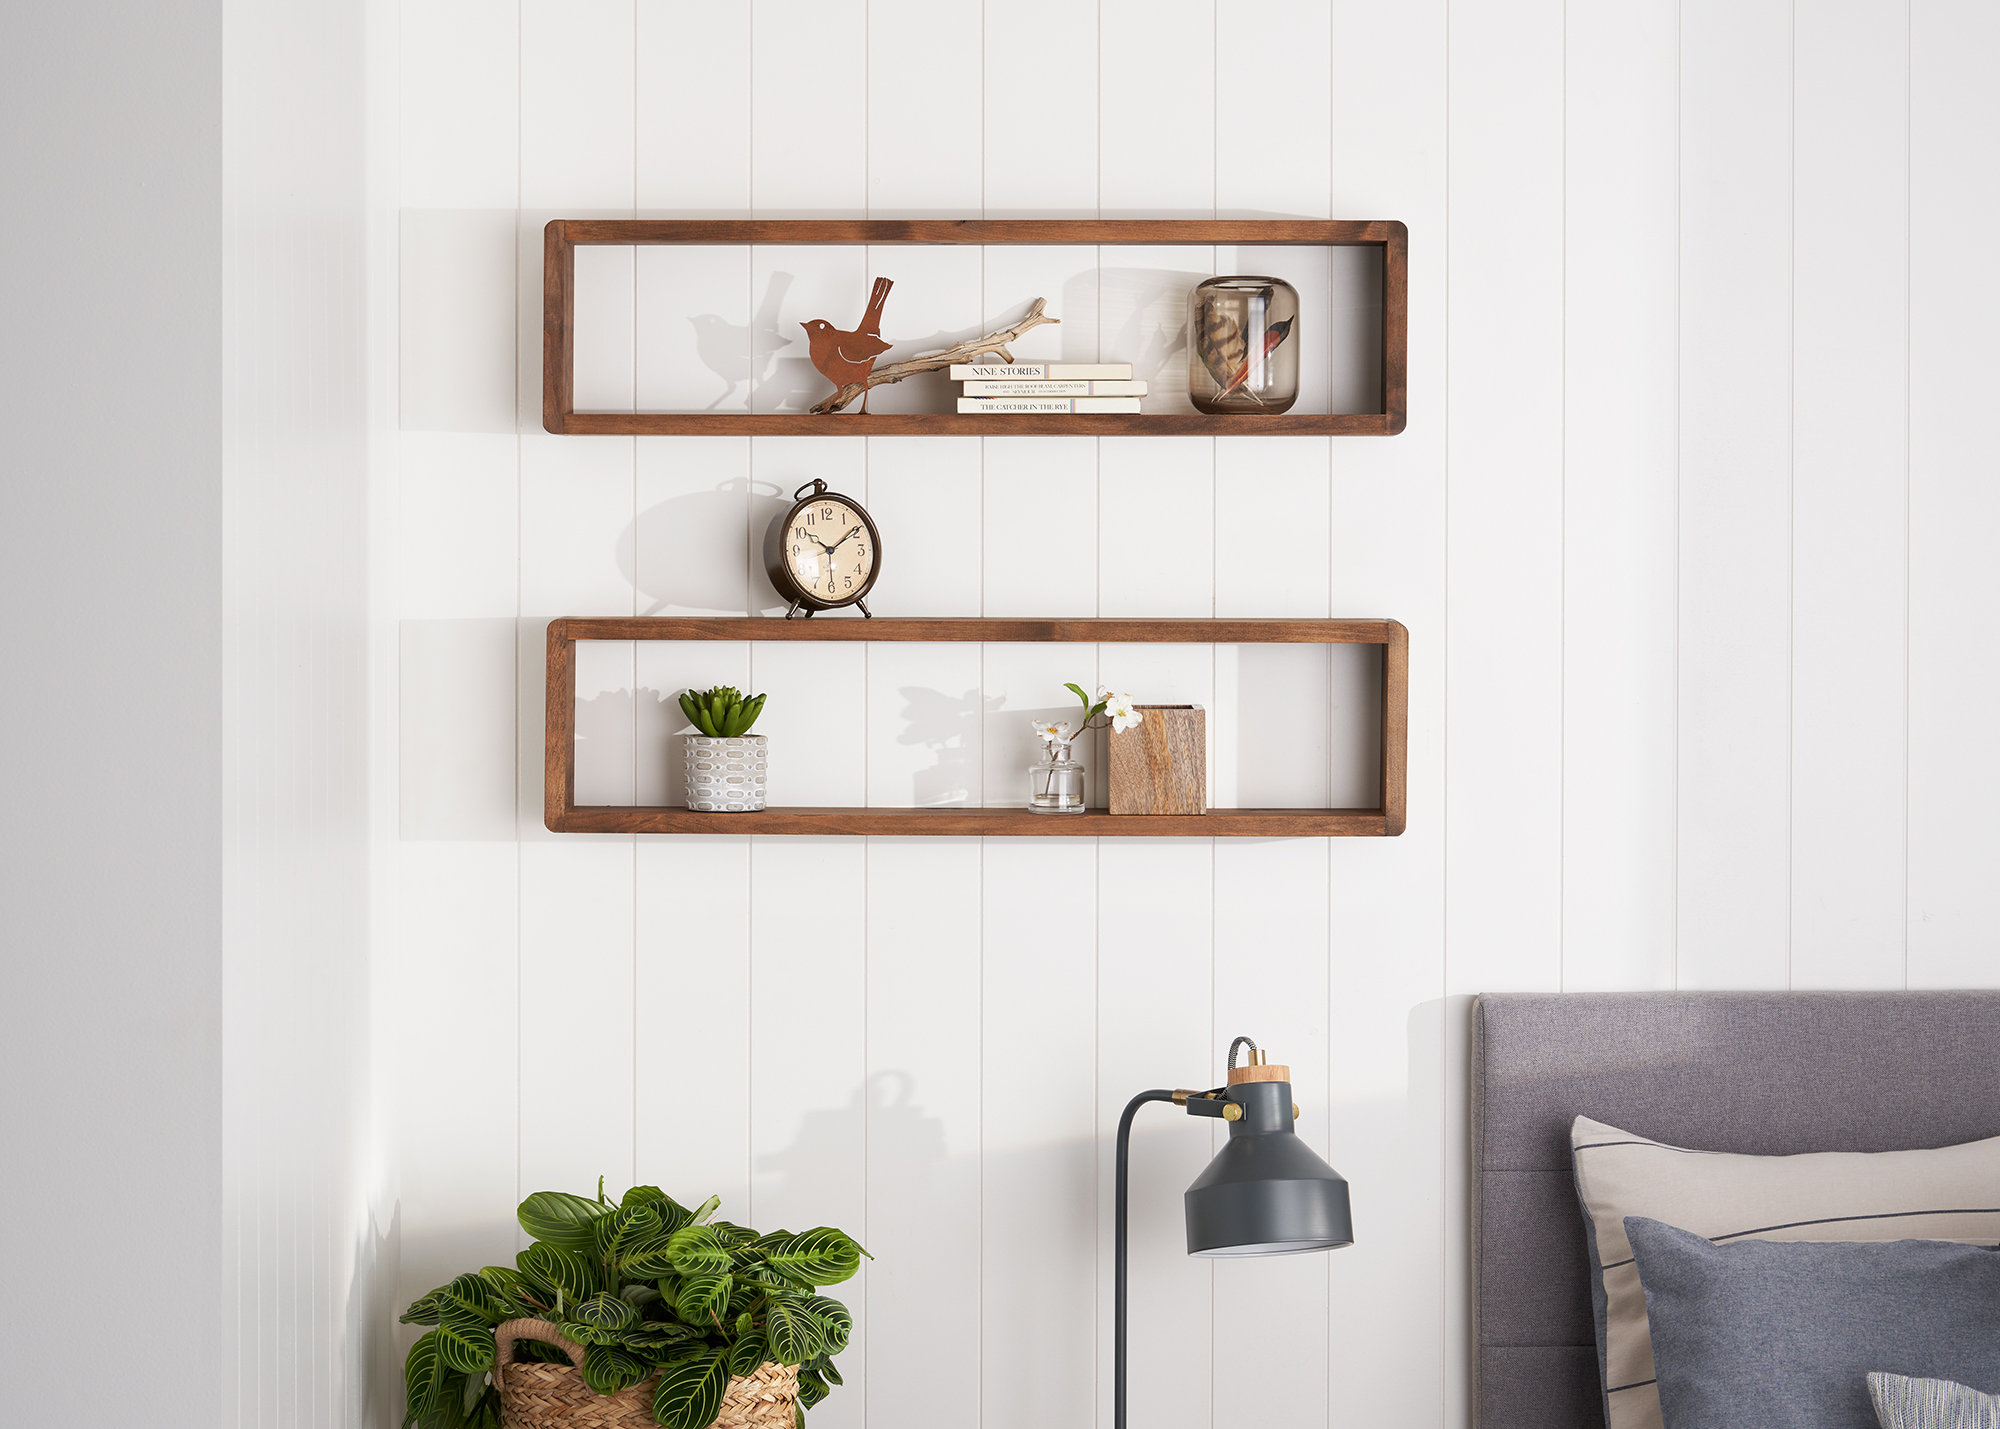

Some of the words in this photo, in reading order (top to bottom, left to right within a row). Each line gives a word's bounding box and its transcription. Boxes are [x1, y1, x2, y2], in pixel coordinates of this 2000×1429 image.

[972, 367, 997, 376] NINE
[1000, 367, 1041, 376] STORIES
[807, 514, 814, 525] 11
[821, 508, 832, 520] 12
[842, 513, 846, 525] 1
[796, 527, 806, 539] 10
[792, 544, 800, 556] 9
[858, 544, 865, 556] 3
[854, 563, 862, 575] 4
[812, 576, 820, 589] 7
[828, 581, 836, 594] 6
[844, 576, 852, 588] 5
